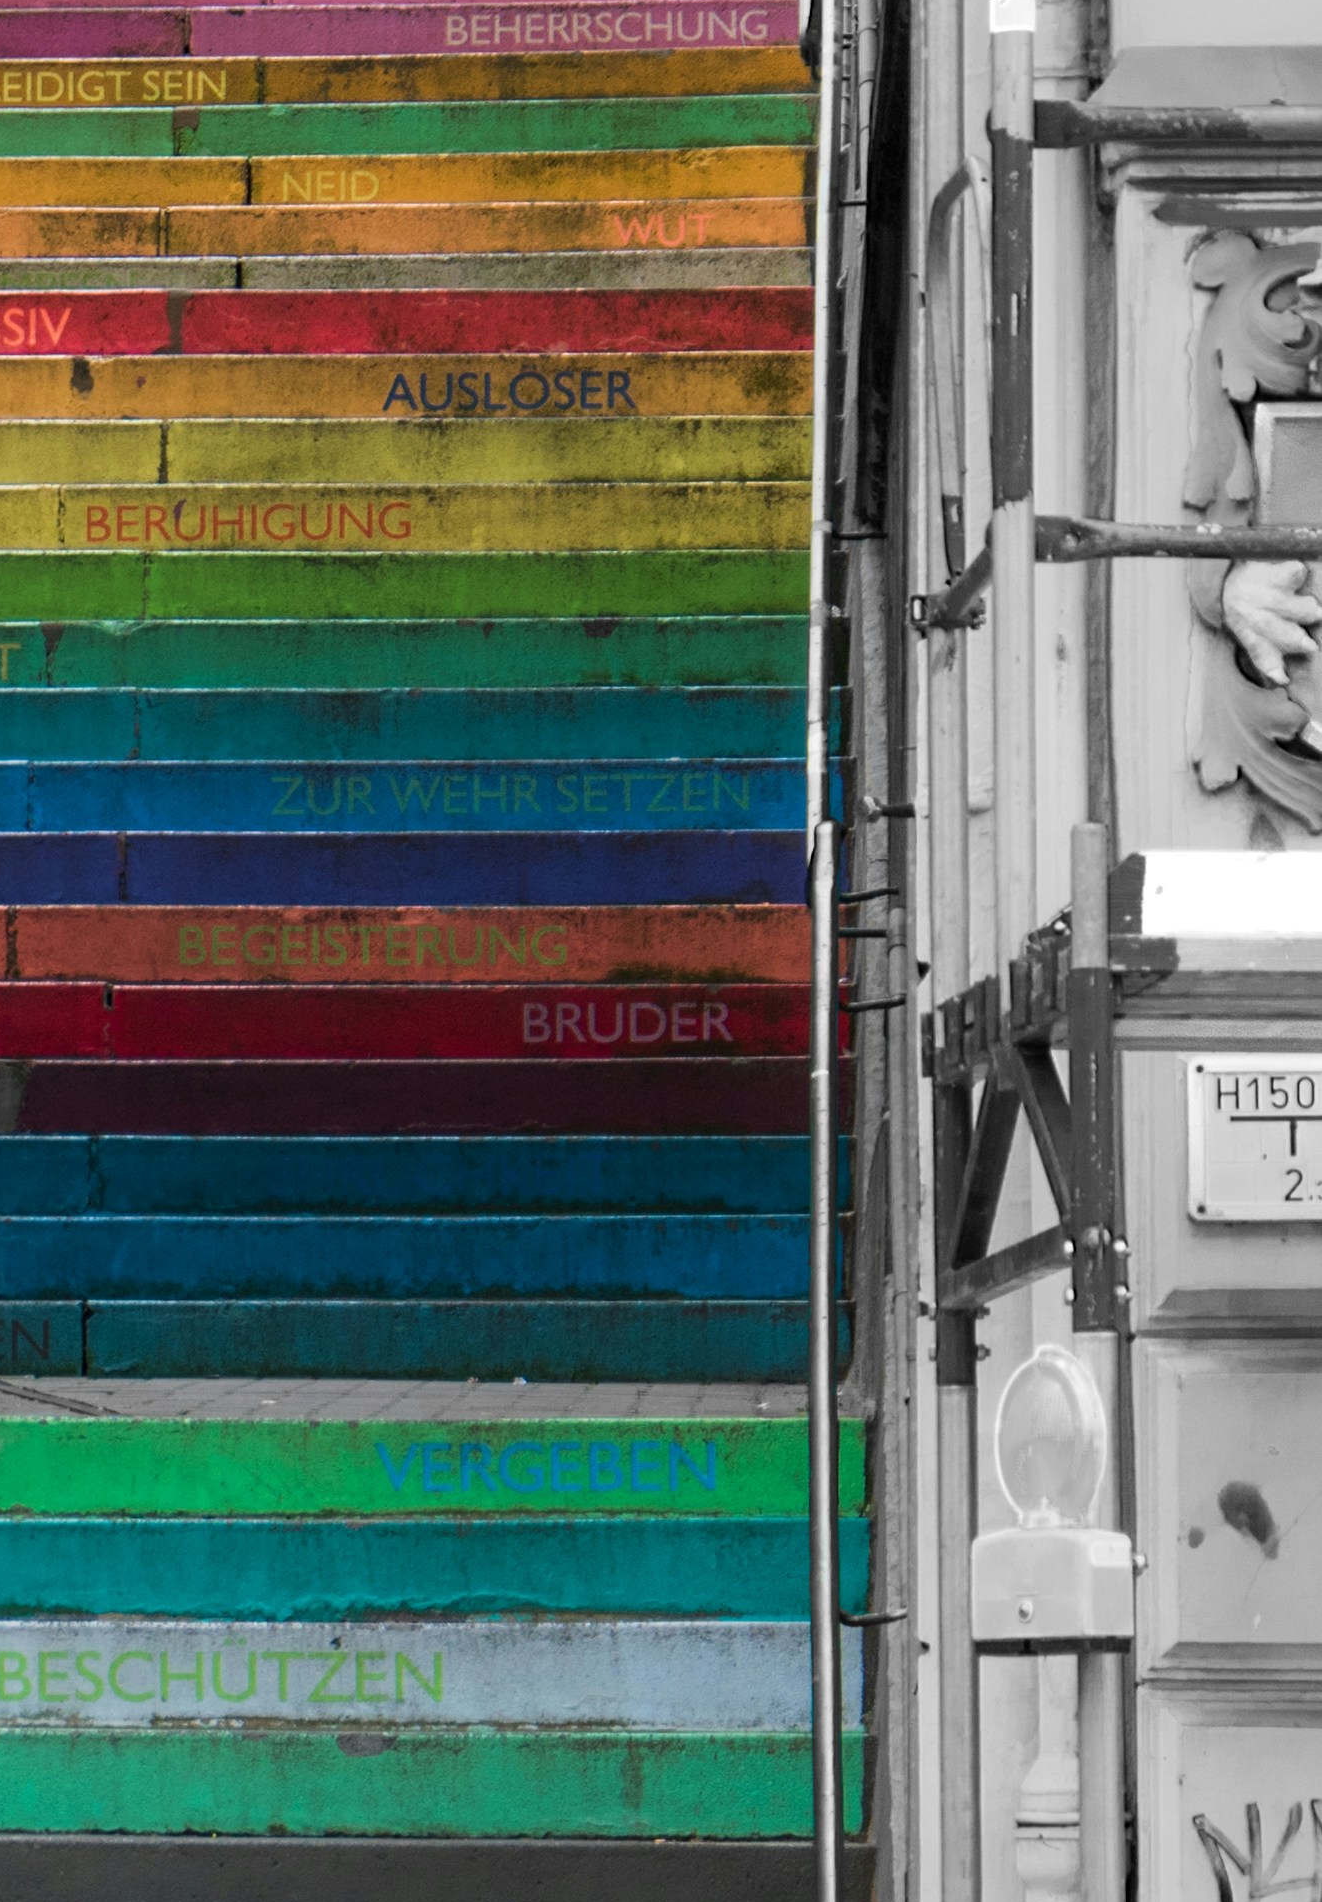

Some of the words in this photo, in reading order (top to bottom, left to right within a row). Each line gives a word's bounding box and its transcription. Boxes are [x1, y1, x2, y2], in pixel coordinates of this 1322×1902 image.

[445, 10, 769, 46] BEHERRSCHUNG
[142, 69, 227, 101] SEIN
[282, 170, 380, 202] NEID
[614, 213, 716, 247] WUT
[383, 364, 636, 411] AUSLÖSER
[85, 501, 412, 543] BERUHIGUNG
[271, 776, 376, 815] ZUR
[389, 775, 541, 814] WEHR
[556, 773, 750, 812] SETZEN
[179, 926, 567, 966] BEGEISTERUNG
[523, 1002, 733, 1043] BRUDER
[1218, 1076, 1315, 1110] H150
[375, 1441, 717, 1493] VERGEBEN
